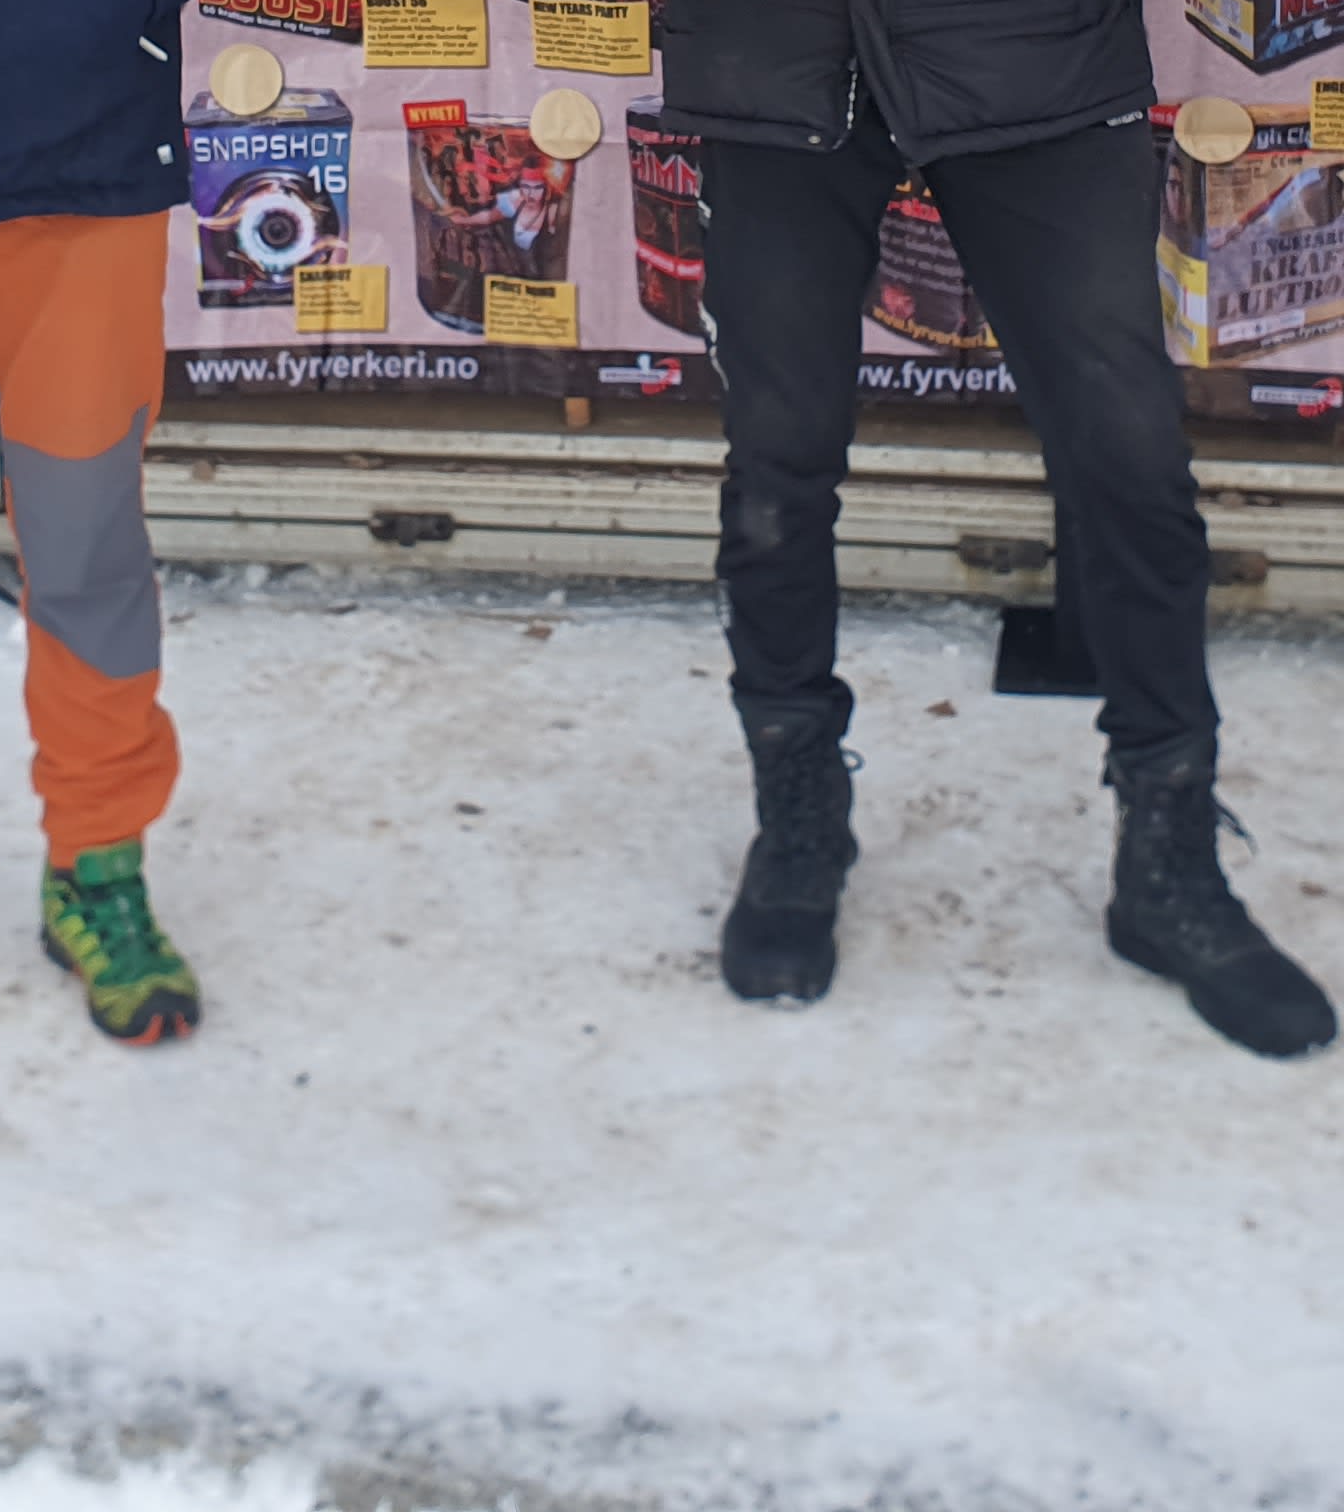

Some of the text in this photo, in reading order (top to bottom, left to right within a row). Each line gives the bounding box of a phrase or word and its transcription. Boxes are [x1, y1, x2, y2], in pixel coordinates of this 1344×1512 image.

[409, 105, 461, 125] NYHET!
[193, 131, 349, 164] SNAPSHOT
[308, 164, 348, 195] 16
[186, 349, 480, 391] www.fyrverkeri.no
